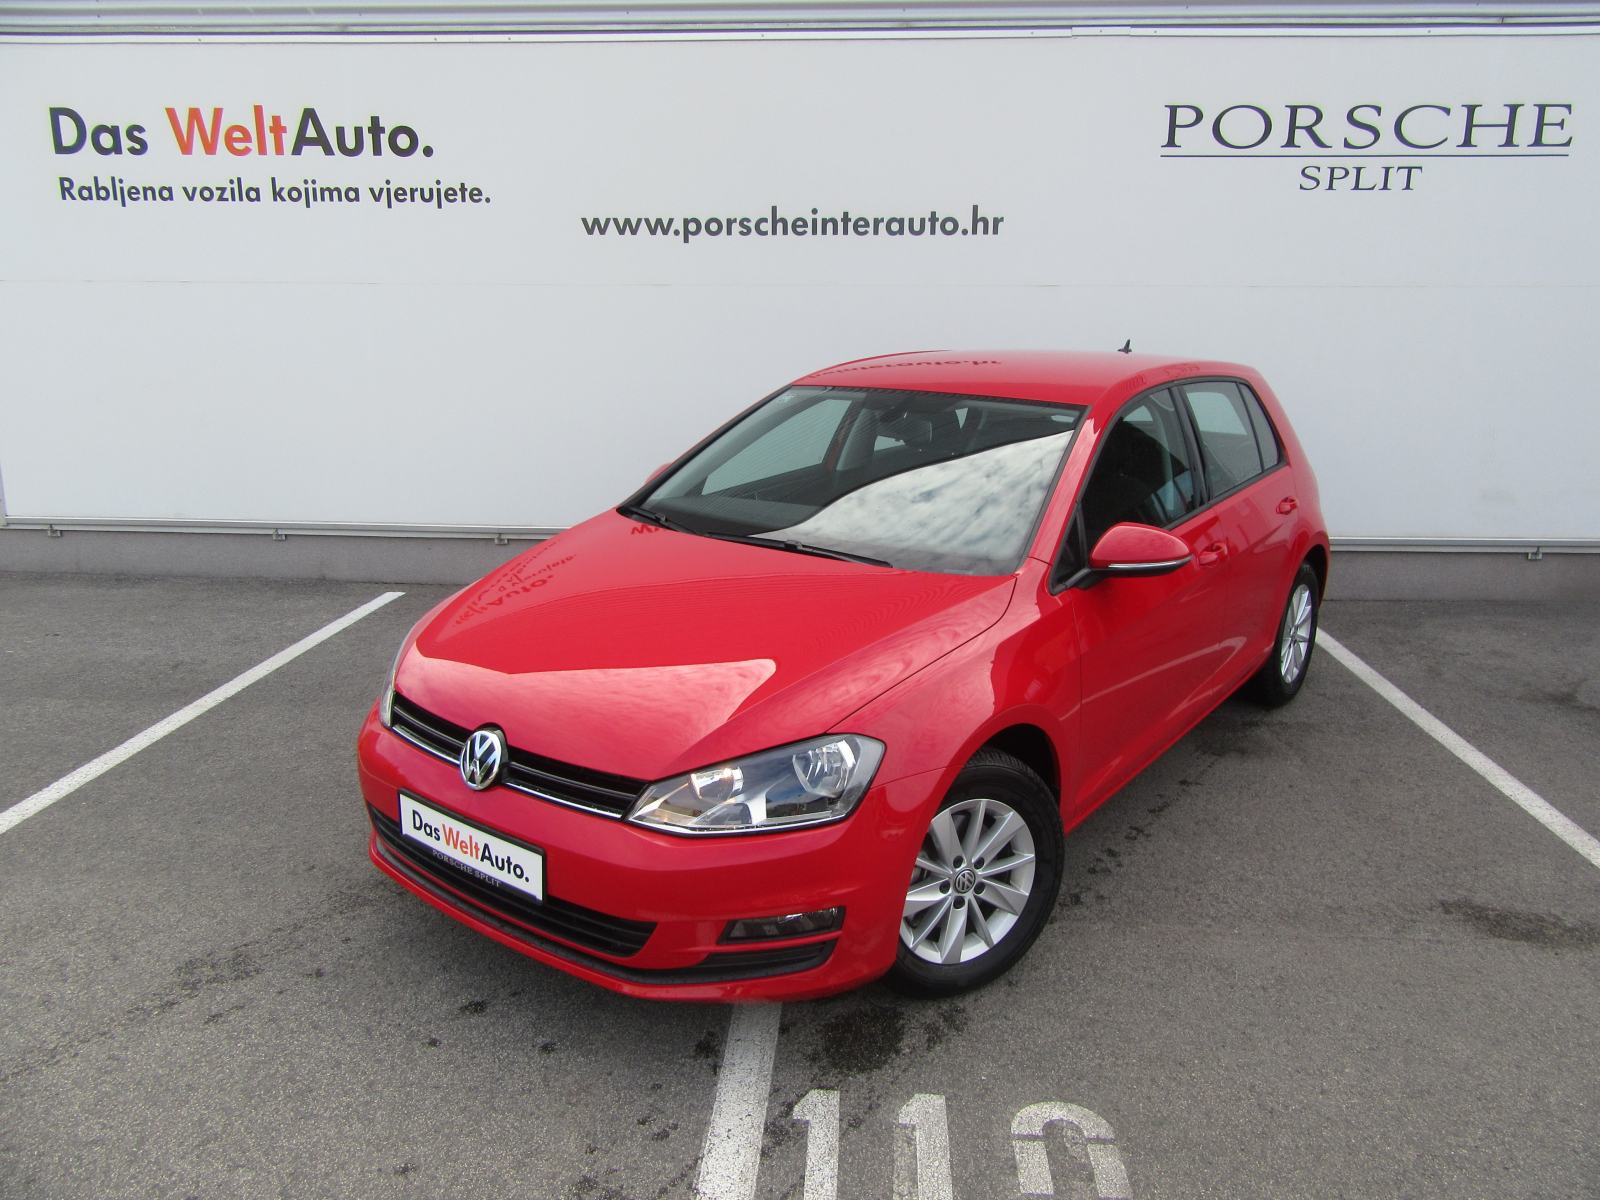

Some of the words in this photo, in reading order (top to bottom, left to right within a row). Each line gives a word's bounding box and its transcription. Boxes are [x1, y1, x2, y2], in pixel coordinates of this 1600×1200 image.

[49, 107, 148, 155] Das
[165, 105, 433, 157] WeltAuto.
[1161, 104, 1572, 149] PORSCHE
[59, 176, 173, 207] Rabljena
[182, 177, 260, 202] vozila
[271, 177, 359, 208] kojima
[369, 180, 490, 209] vjerujete.
[1300, 166, 1422, 190] SPLIT
[581, 205, 1004, 243] www.porscheinterauto.hr
[412, 808, 441, 841] Das
[442, 823, 530, 883] WeltAuto.
[432, 849, 473, 875] PORSCHE
[474, 870, 501, 888] SPLIT
